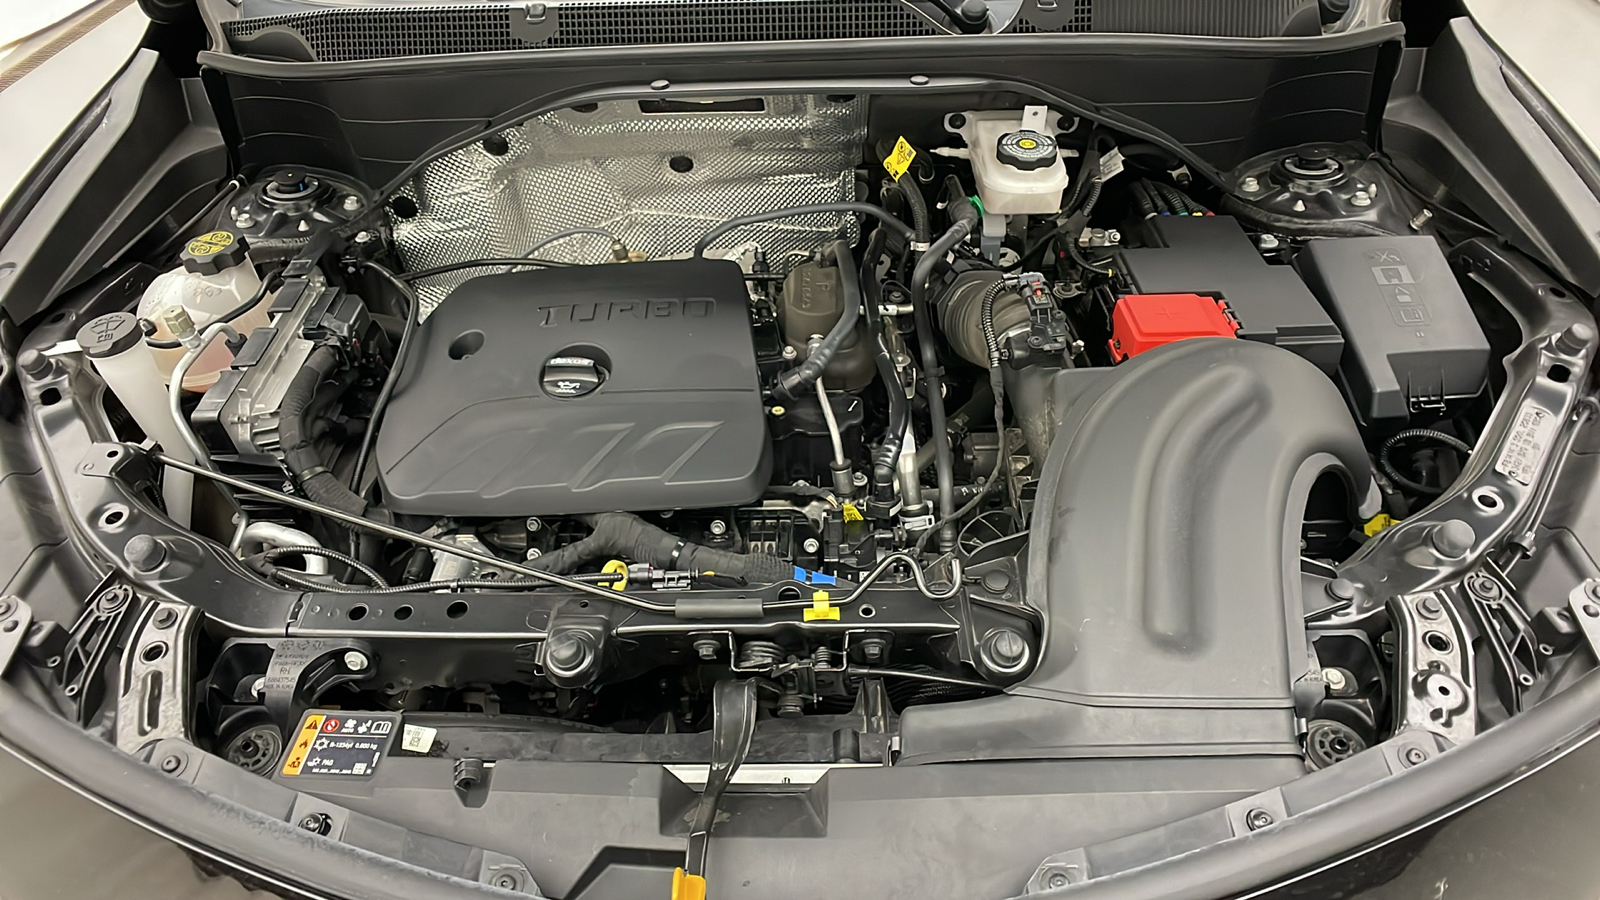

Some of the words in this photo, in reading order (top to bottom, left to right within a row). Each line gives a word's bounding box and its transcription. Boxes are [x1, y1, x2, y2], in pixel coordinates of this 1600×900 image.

[538, 297, 717, 328] TURBO
[279, 667, 291, 675] RH
[370, 742, 378, 750] kg
